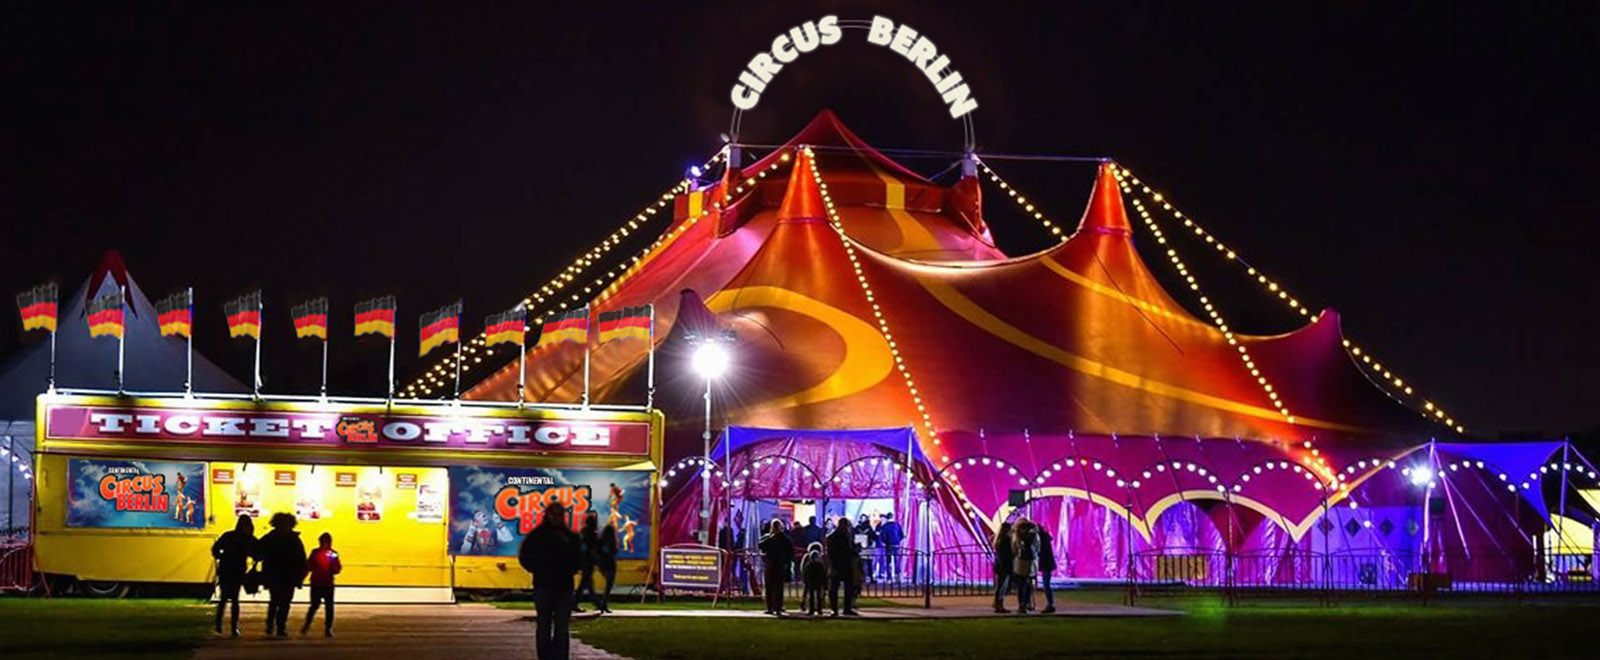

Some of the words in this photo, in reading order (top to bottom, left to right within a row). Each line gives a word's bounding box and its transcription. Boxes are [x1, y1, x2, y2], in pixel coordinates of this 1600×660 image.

[731, 15, 843, 110] CIRCUS
[868, 15, 979, 119] BERLIN
[90, 413, 333, 438] TICKET
[382, 421, 610, 446] OFFICE
[99, 475, 163, 499] CIRCUS
[507, 476, 554, 484] CONTINENTAL
[117, 493, 168, 511] BERLIN
[495, 487, 589, 519] CIRCUS
